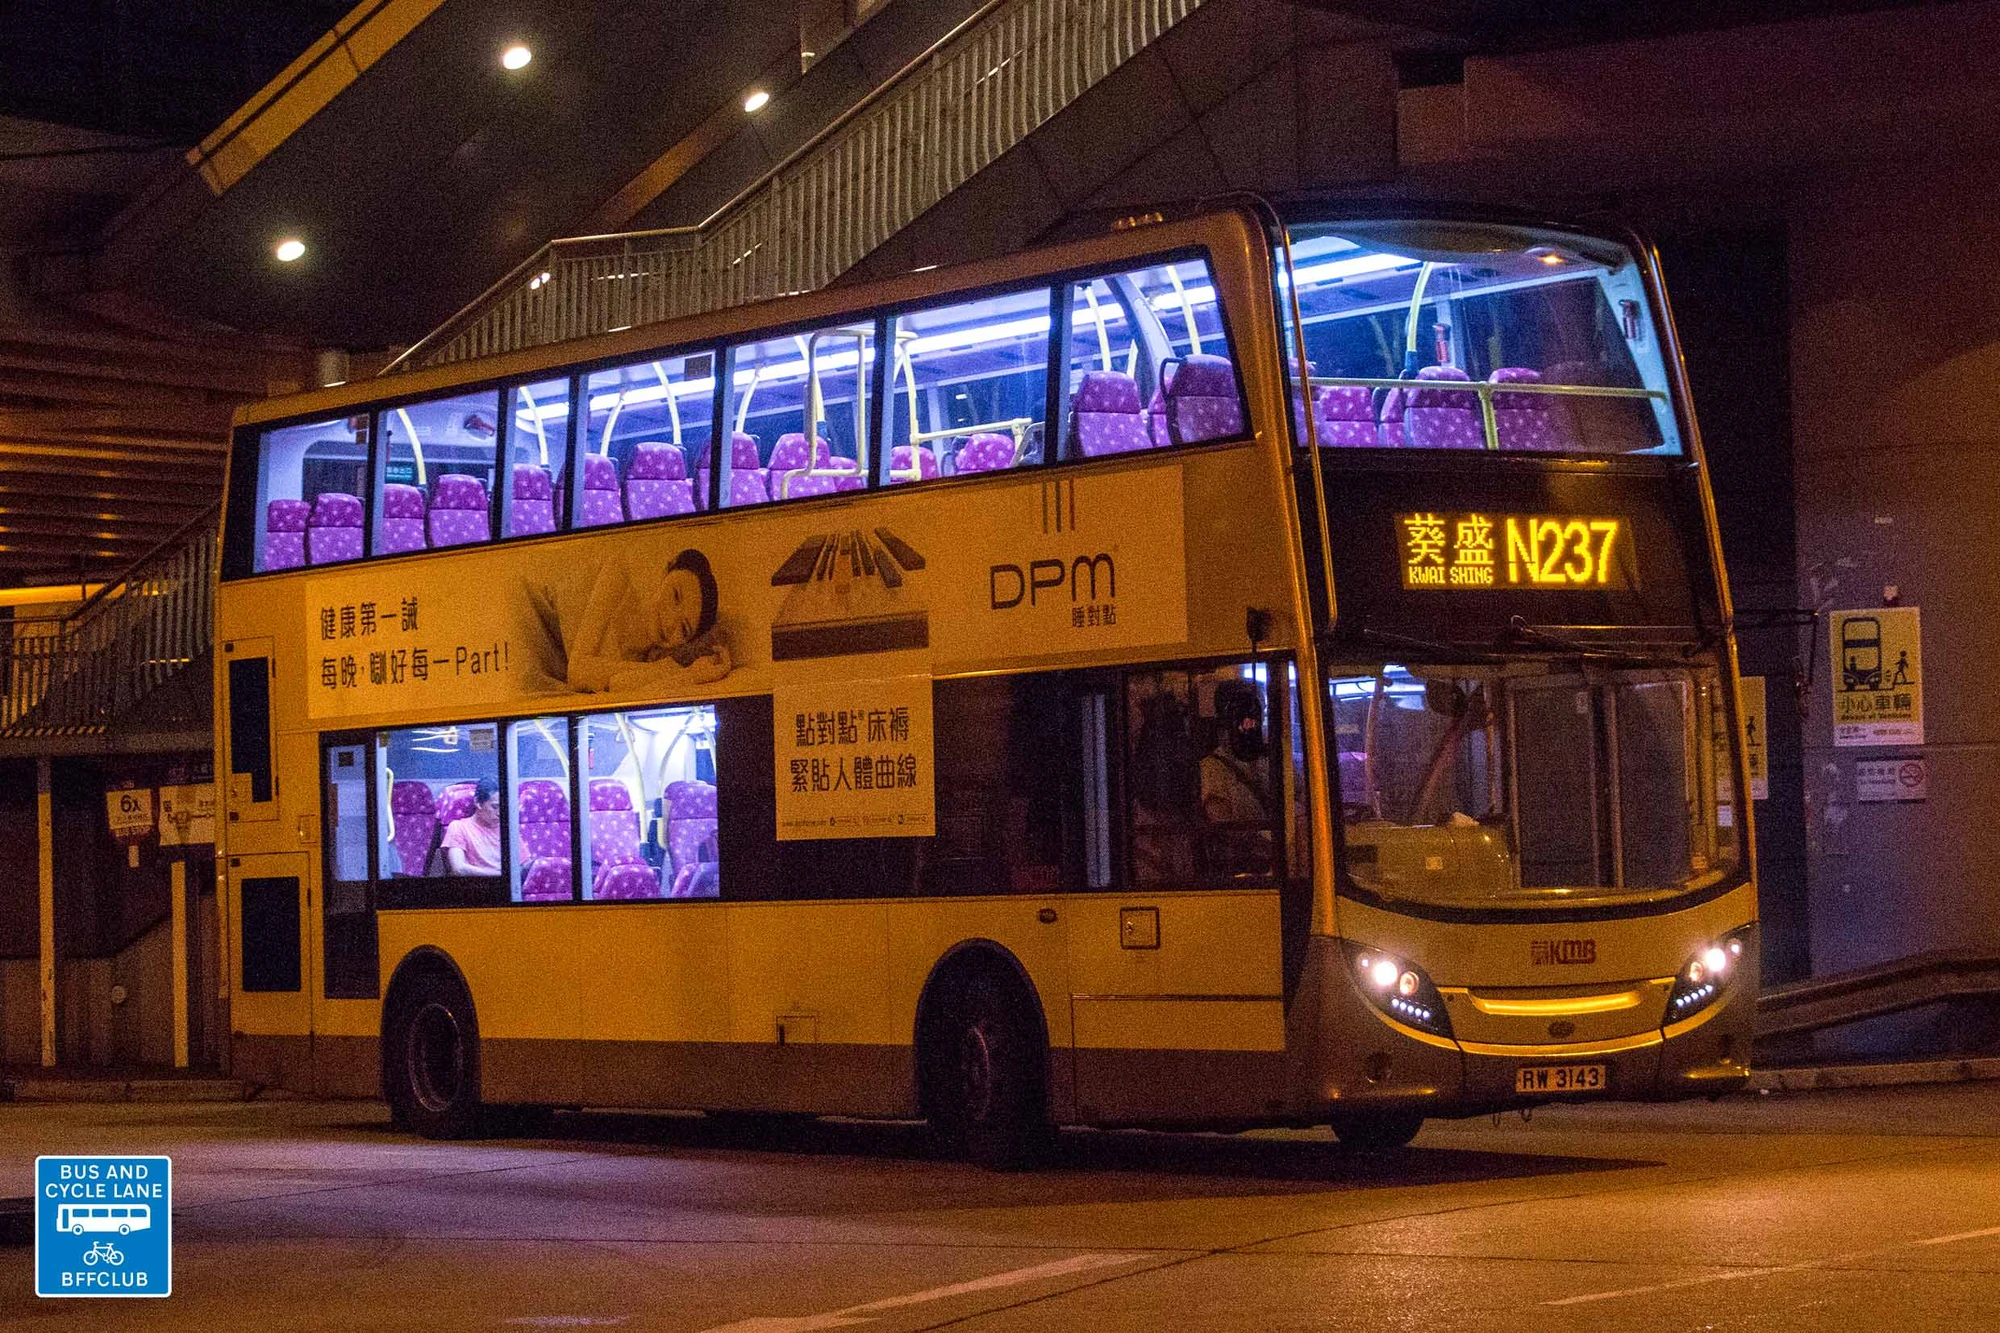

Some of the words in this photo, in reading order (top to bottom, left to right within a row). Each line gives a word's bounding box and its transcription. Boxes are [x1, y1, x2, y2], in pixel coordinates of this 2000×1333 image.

[1404, 513, 1494, 564] 葵盛
[1506, 518, 1618, 583] N237
[990, 553, 1116, 610] DPM
[1408, 566, 1446, 584] KWAI
[1450, 566, 1493, 584] SHING
[320, 596, 419, 641] 健康第一誡
[1071, 604, 1117, 628] 睡對點
[790, 754, 917, 793] 緊貼人體曲線
[1550, 939, 1597, 965] KMB
[1522, 1069, 1549, 1089] RW
[1556, 1067, 1600, 1088] 3143
